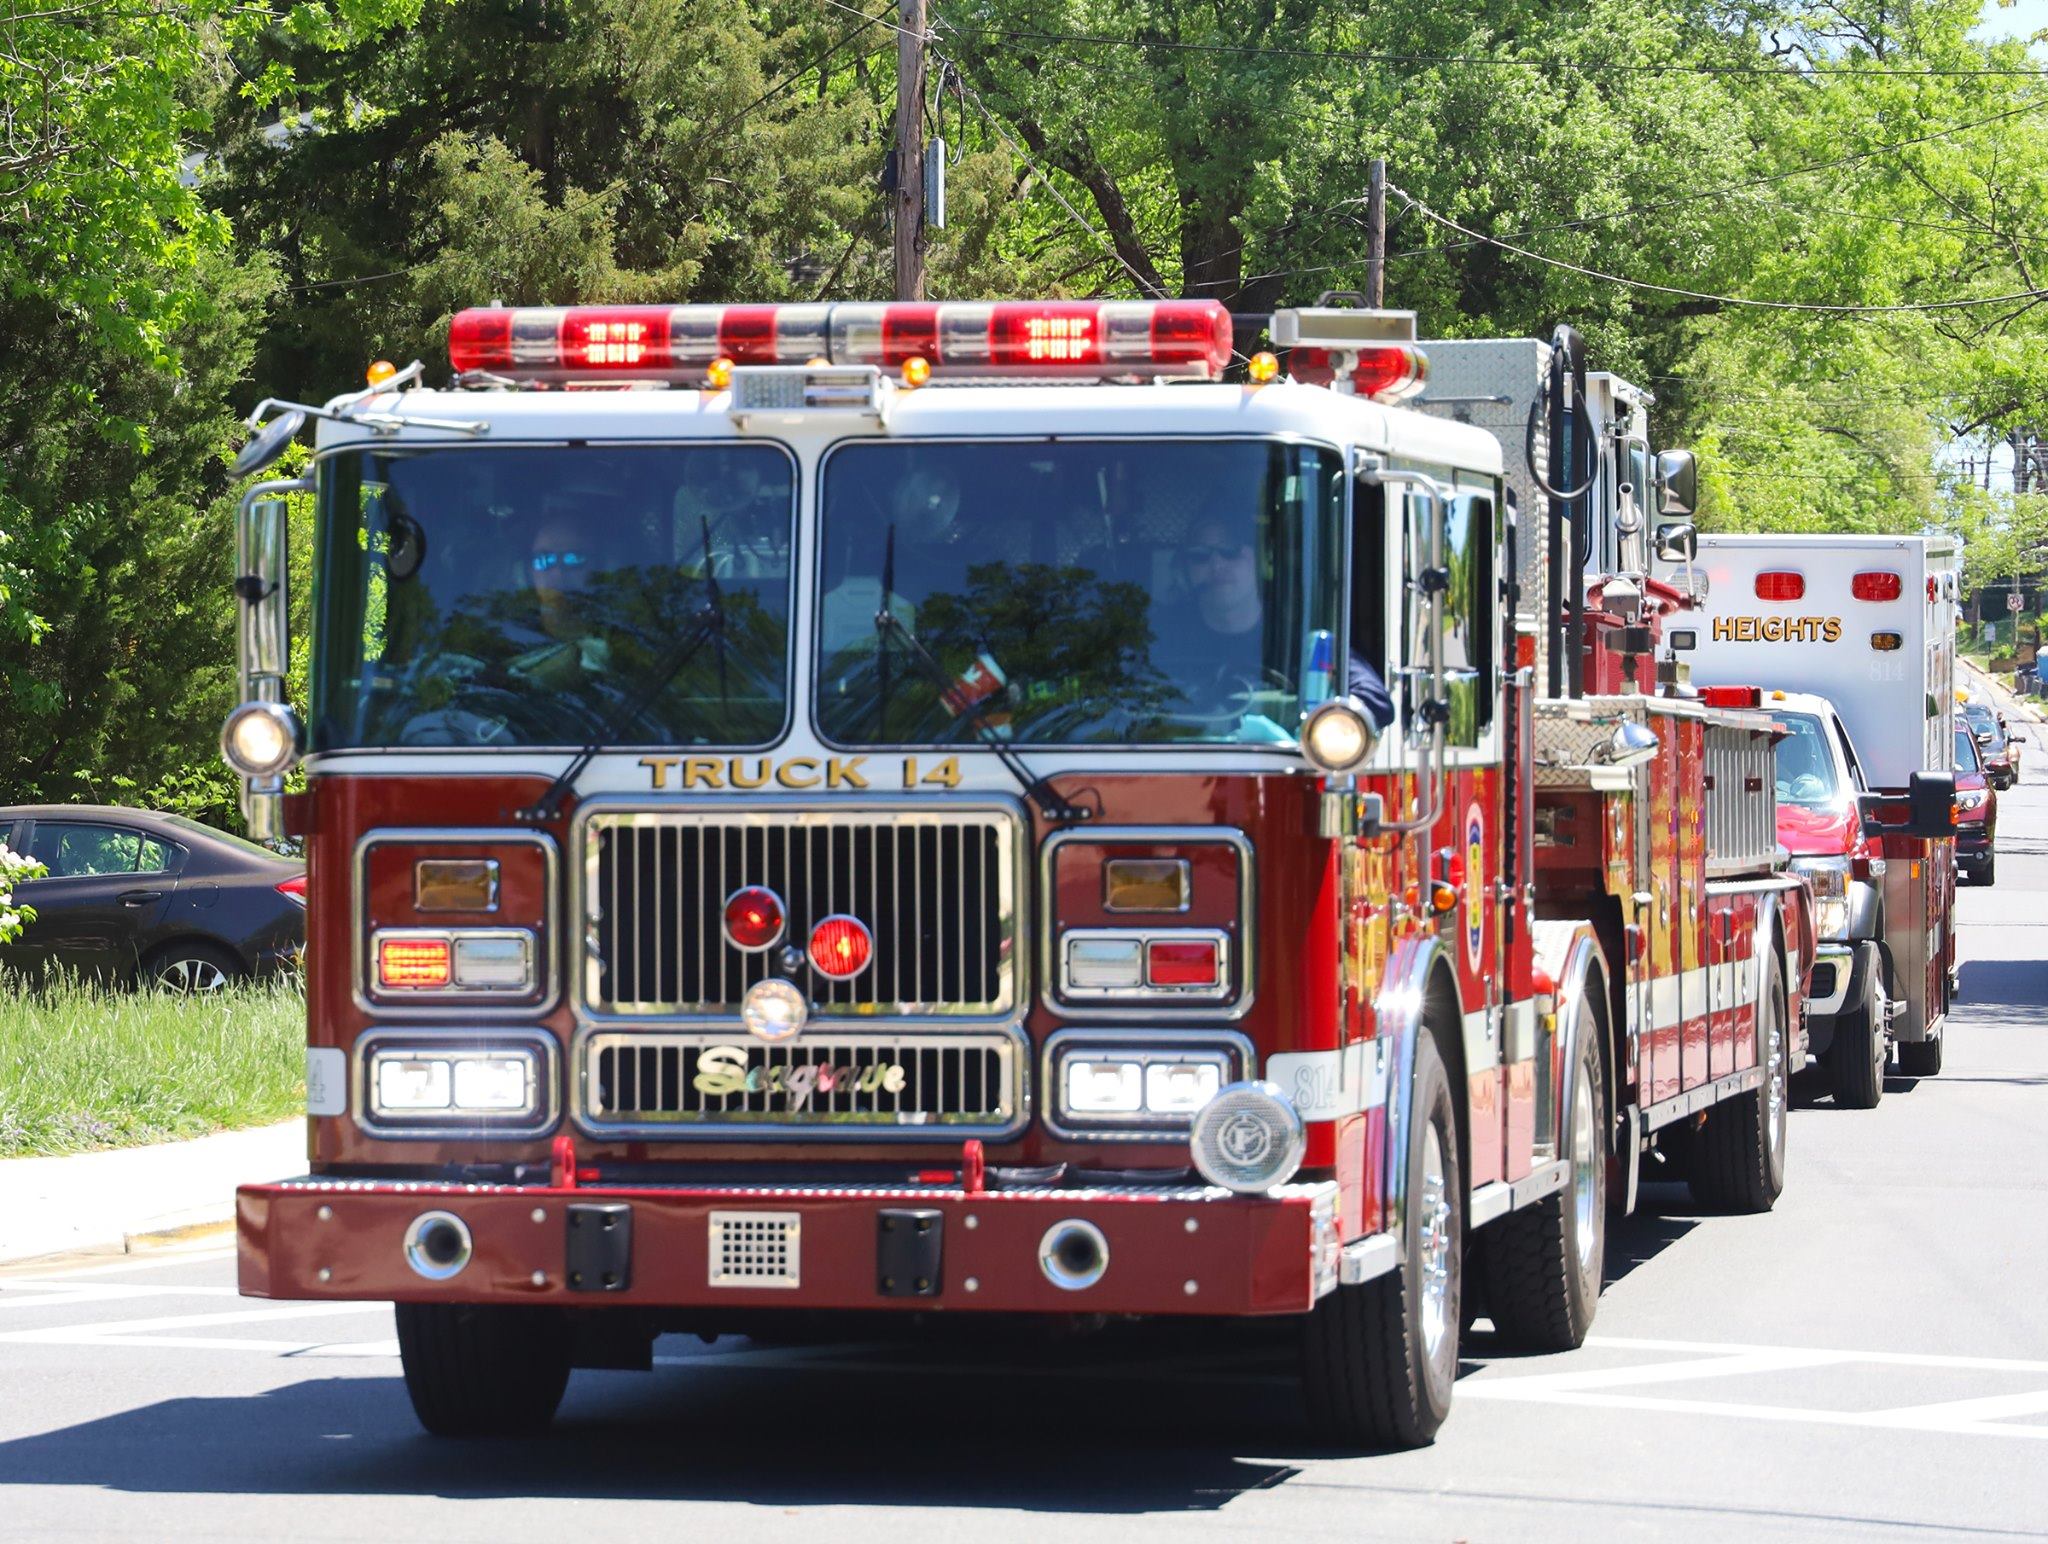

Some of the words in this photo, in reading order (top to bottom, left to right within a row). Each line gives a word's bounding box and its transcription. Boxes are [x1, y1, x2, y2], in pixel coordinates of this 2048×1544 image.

[1713, 616, 1842, 642] HEIGHTS
[1870, 660, 1904, 681] 814
[640, 757, 869, 788] TRUCK
[902, 757, 963, 788] 14
